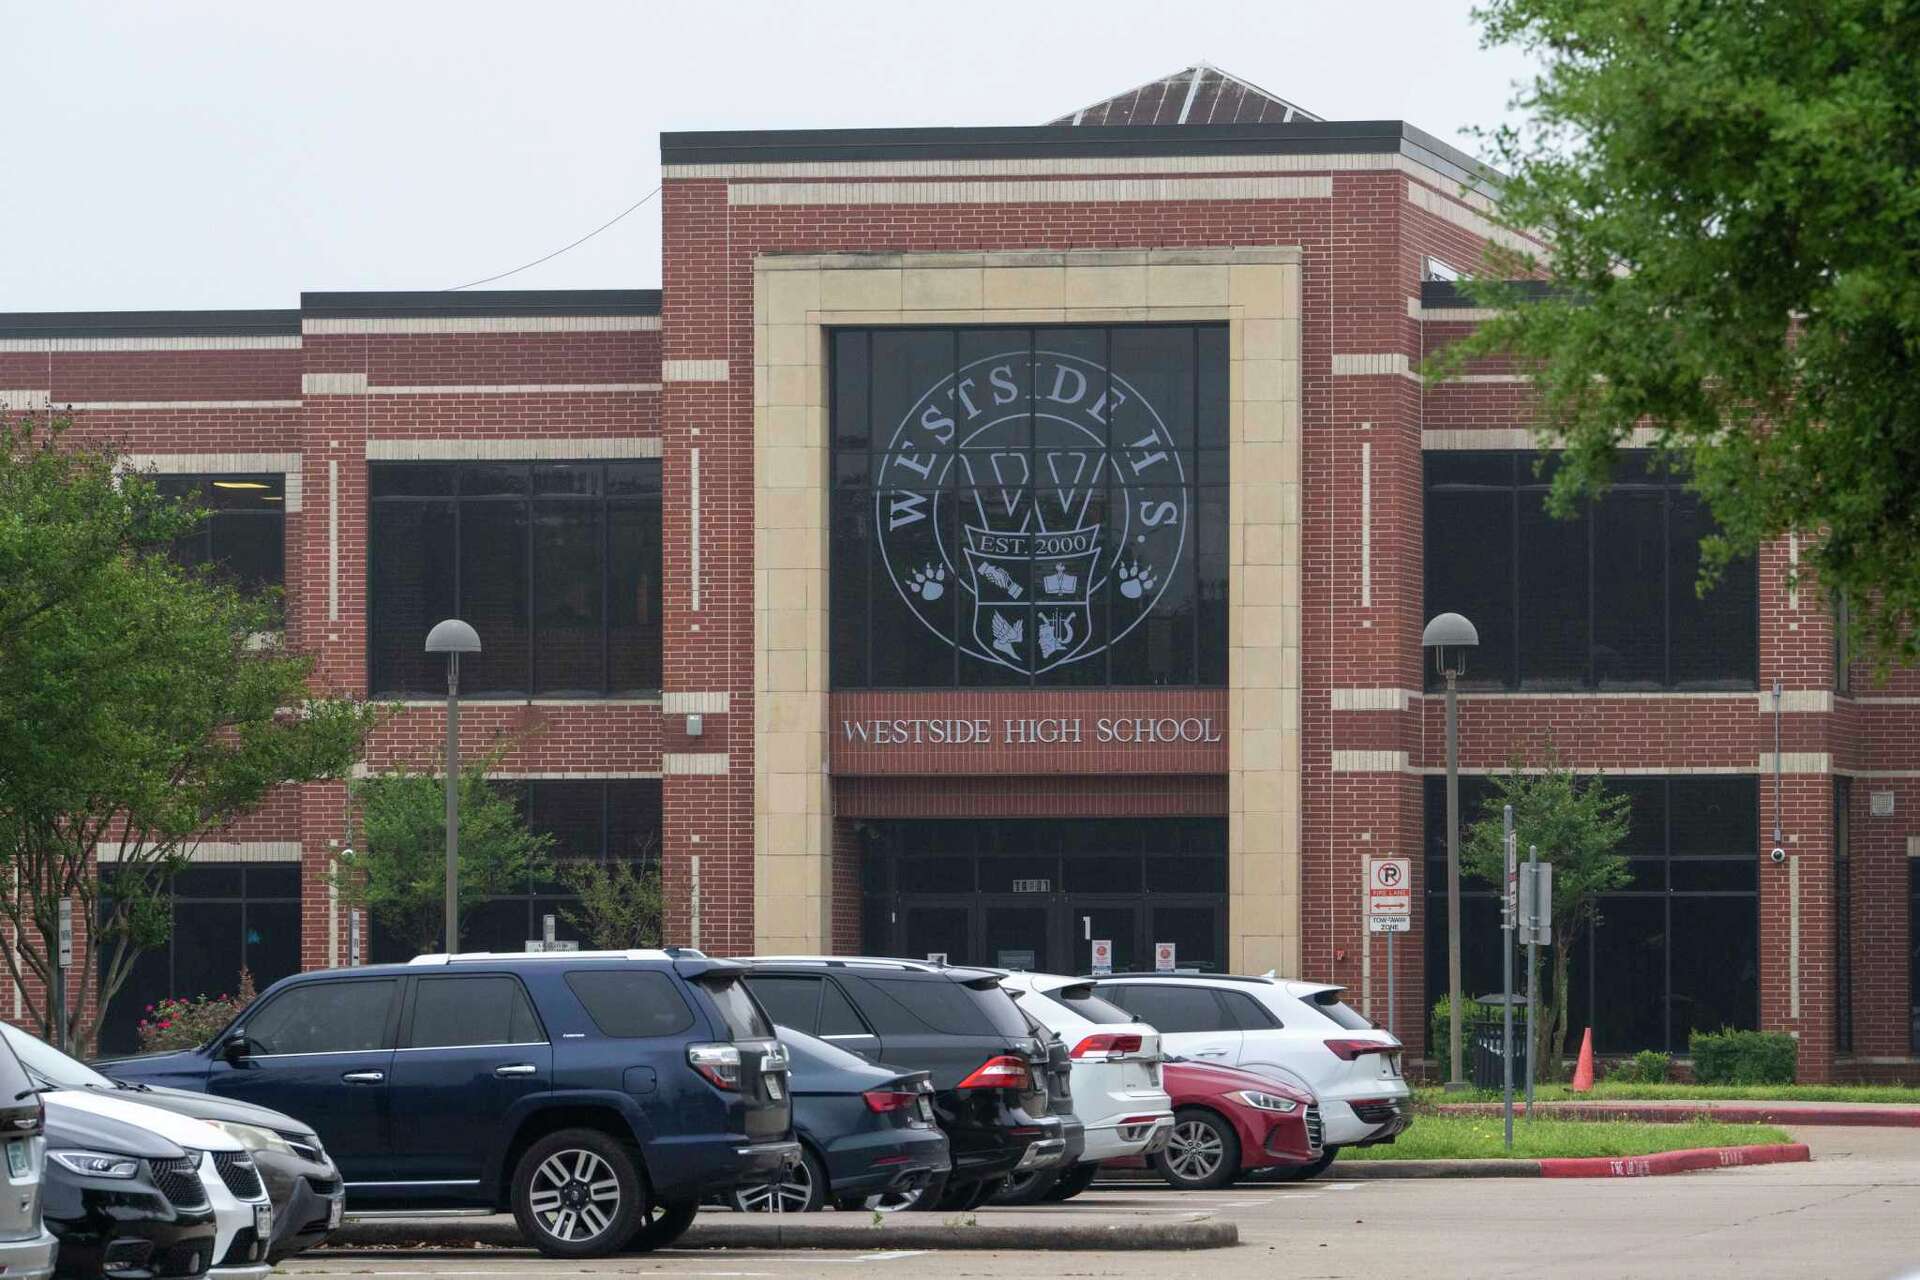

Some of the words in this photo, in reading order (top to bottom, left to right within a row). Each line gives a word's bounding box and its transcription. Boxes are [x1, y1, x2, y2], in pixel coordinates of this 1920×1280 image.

[890, 363, 1126, 532] WESTSIDE
[980, 535, 1028, 554] EST.
[1035, 535, 1086, 554] 2000
[842, 719, 992, 744] WESTSIDE
[1003, 718, 1082, 744] HIGH
[1096, 718, 1223, 743] SCHOOL
